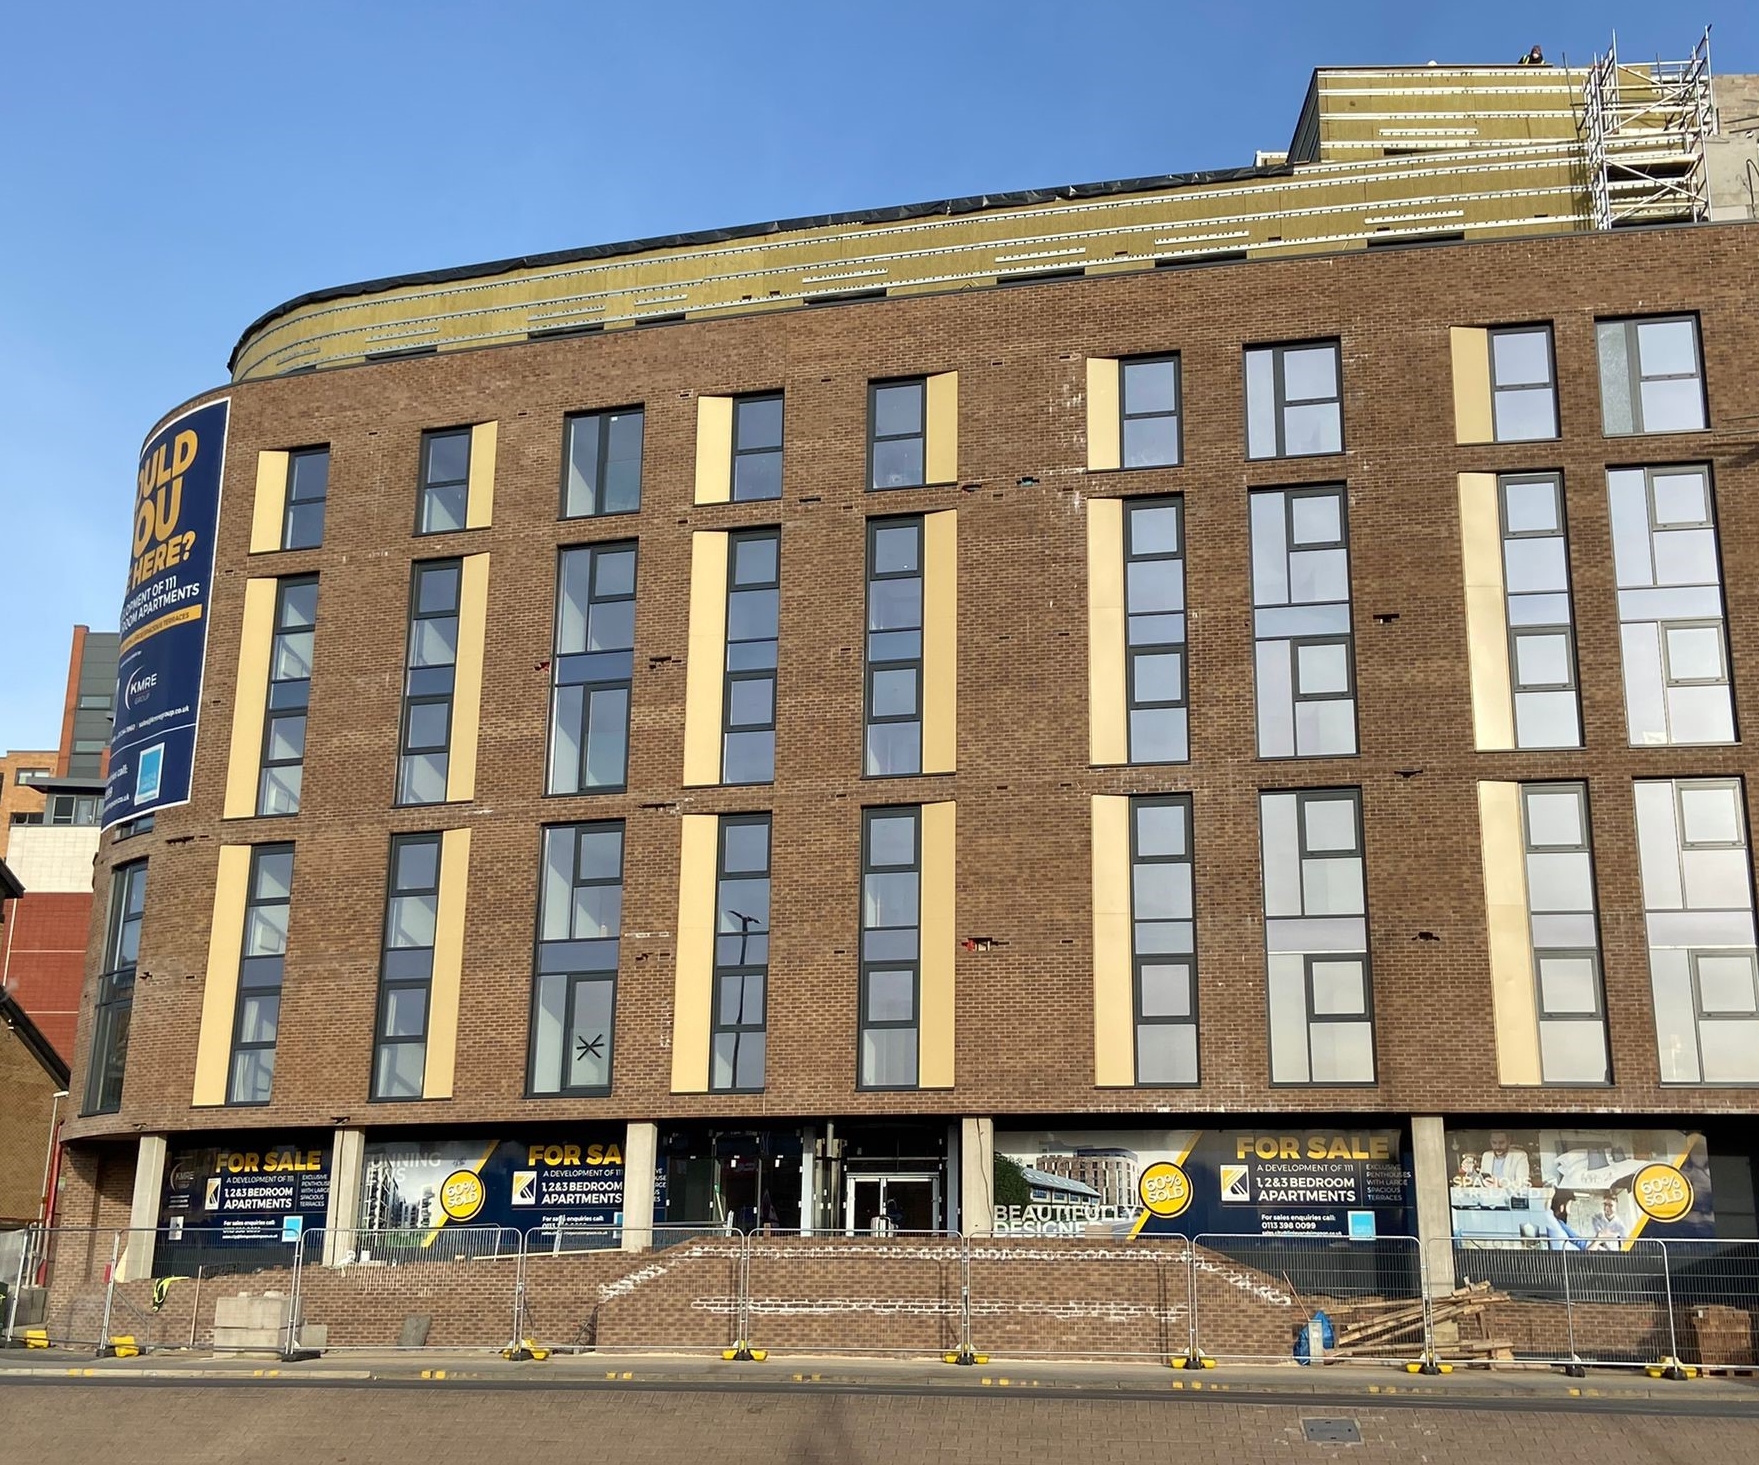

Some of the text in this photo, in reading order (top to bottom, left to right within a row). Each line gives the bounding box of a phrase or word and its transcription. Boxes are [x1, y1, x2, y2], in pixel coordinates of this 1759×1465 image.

[132, 531, 195, 590] HERE?
[152, 580, 164, 597] OF
[165, 575, 177, 591] 111
[138, 582, 200, 621] APARTMENTS
[130, 673, 158, 695] KMRE
[528, 1144, 581, 1166] FOR
[1236, 1136, 1390, 1160] FOR SALE
[215, 1150, 321, 1173] FOR SALE
[1256, 1164, 1354, 1172] A DEVELOPMENT OF 111
[232, 1176, 277, 1184] DEVELOPMENT
[277, 1175, 286, 1183] OF
[550, 1169, 604, 1177] DEVELOPMENT
[604, 1169, 615, 1177] OF
[570, 1181, 622, 1191] BEDROOM
[1145, 1174, 1182, 1193] 60%
[1290, 1177, 1355, 1188] BEDROOM
[1640, 1176, 1680, 1195] 60%
[249, 1187, 293, 1197] BEDROOM
[541, 1193, 622, 1204] APARTMENTS
[1148, 1186, 1185, 1204] SOLD
[1258, 1190, 1356, 1201] APARTMENTS
[1644, 1189, 1685, 1207] SOLD
[224, 1199, 292, 1210] APARTMENTS
[566, 1215, 592, 1224] enquiries
[994, 1205, 1136, 1222] BEAUTIFULLY
[1290, 1214, 1321, 1222] enquiries
[993, 1221, 1103, 1238] DESIGNE
